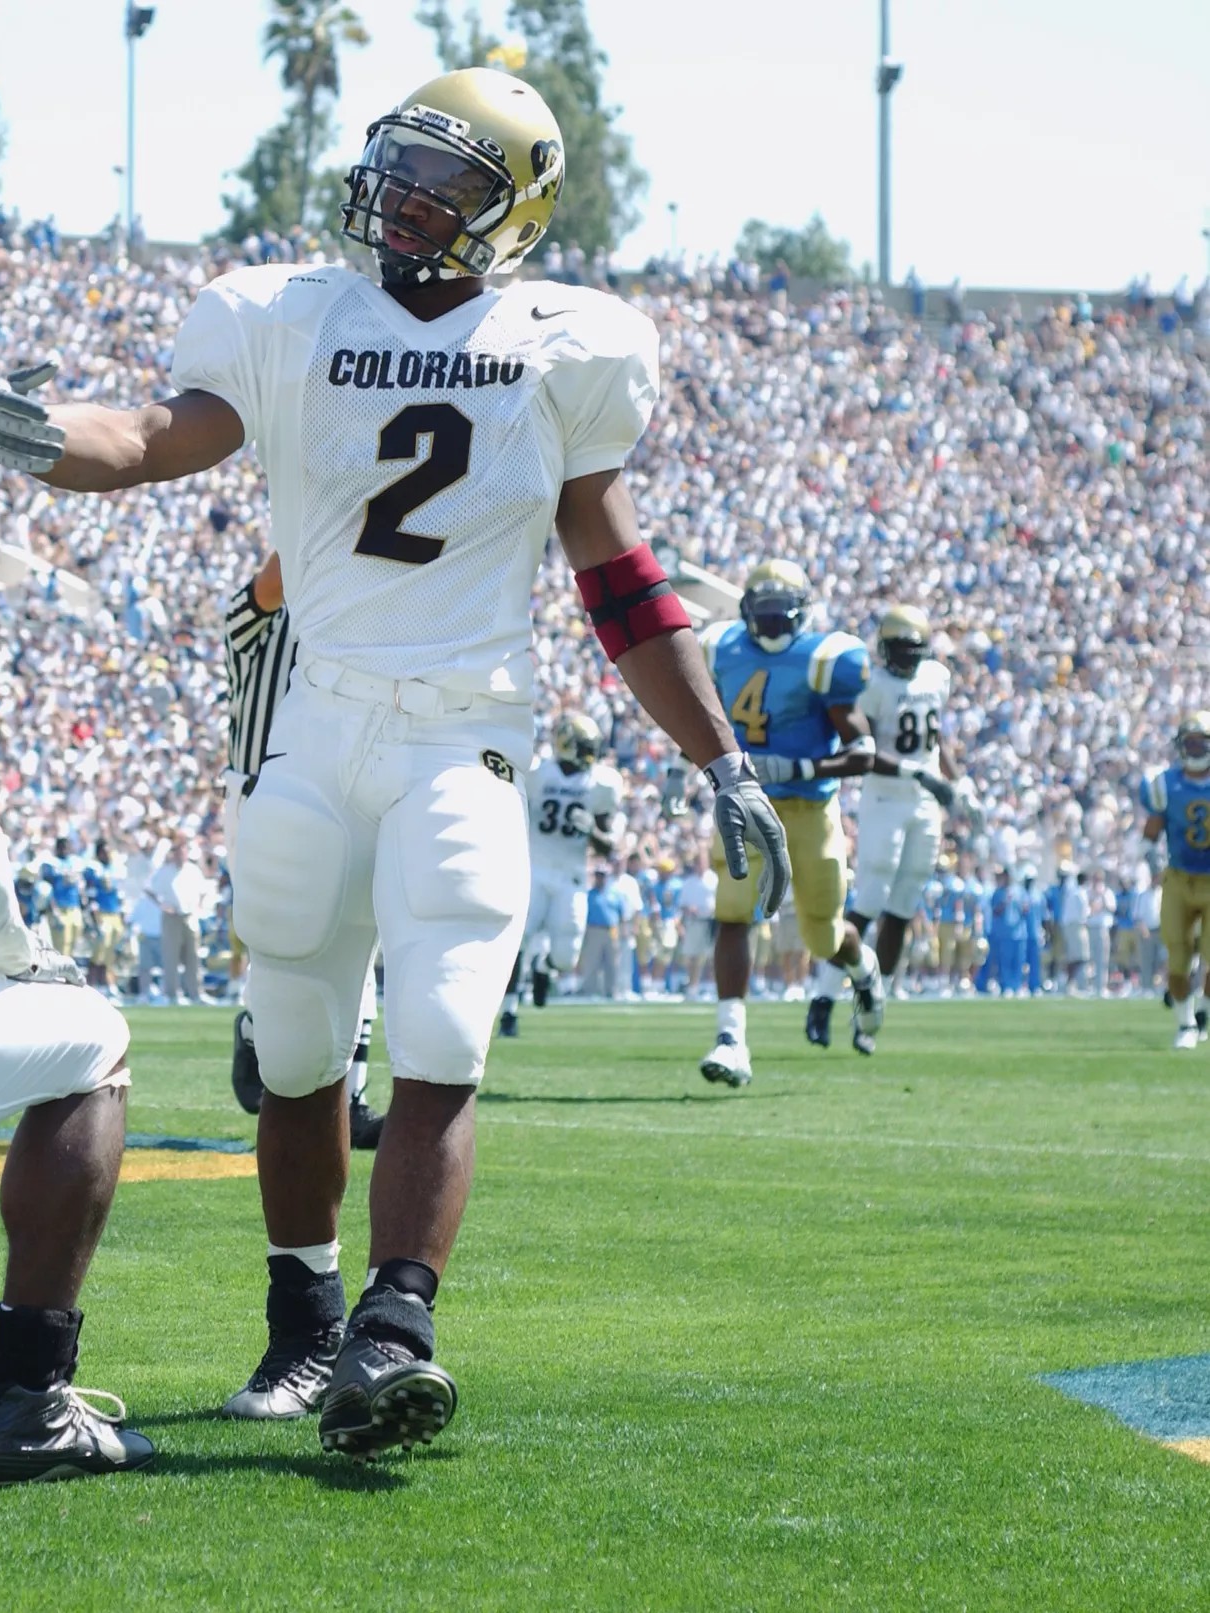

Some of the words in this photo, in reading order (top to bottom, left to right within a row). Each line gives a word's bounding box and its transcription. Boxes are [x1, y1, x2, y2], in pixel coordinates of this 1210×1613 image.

[328, 349, 525, 389] COLORADO
[352, 402, 475, 567] 2
[731, 668, 770, 746] 4
[895, 708, 941, 755] 86
